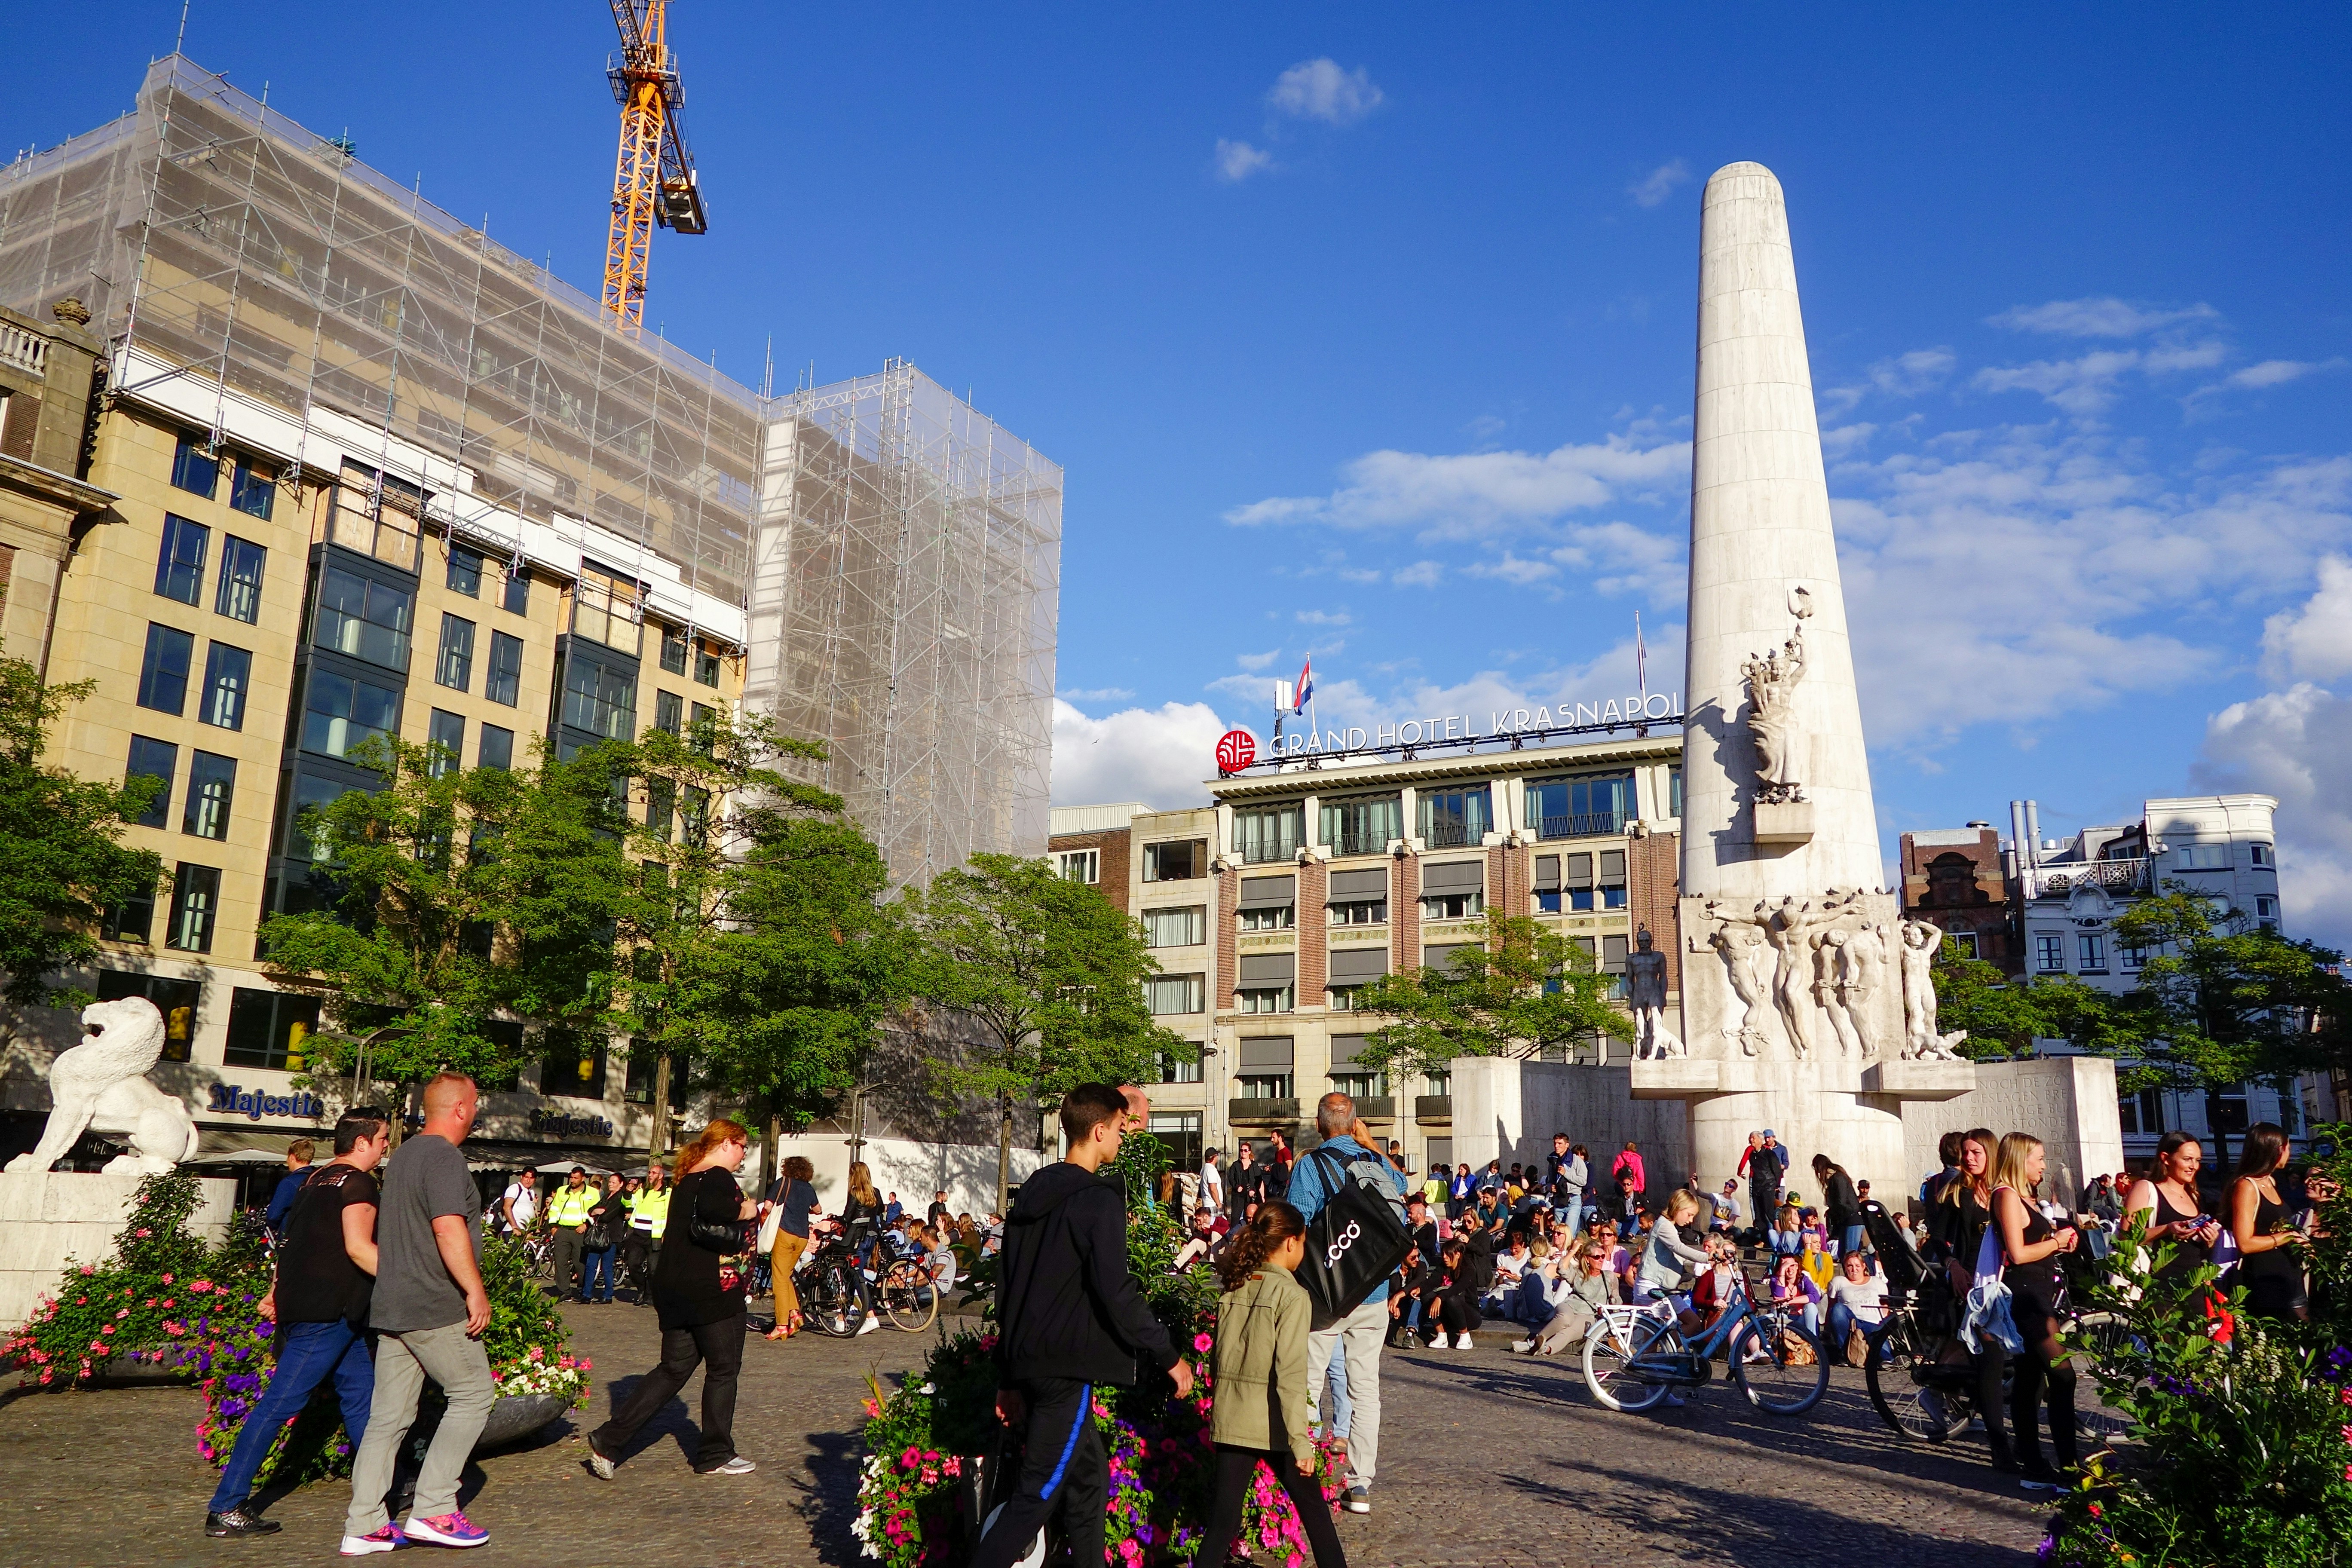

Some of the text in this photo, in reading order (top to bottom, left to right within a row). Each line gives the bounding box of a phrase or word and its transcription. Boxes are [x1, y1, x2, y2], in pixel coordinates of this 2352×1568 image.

[1269, 727, 1367, 758] GRAND
[1378, 715, 1480, 747] HOTEL
[1978, 1078, 2018, 1090] NOCH
[2023, 1077, 2040, 1088] DE
[208, 1083, 324, 1120] Majestic
[1970, 1090, 2039, 1104] GESLAGEN
[1969, 1106, 1999, 1120] ZIJN
[2005, 1104, 2043, 1116] HOGE
[530, 1108, 613, 1139] Majestic
[1923, 1120, 1982, 1131] VOLKEN
[1988, 1120, 2005, 1130] EN
